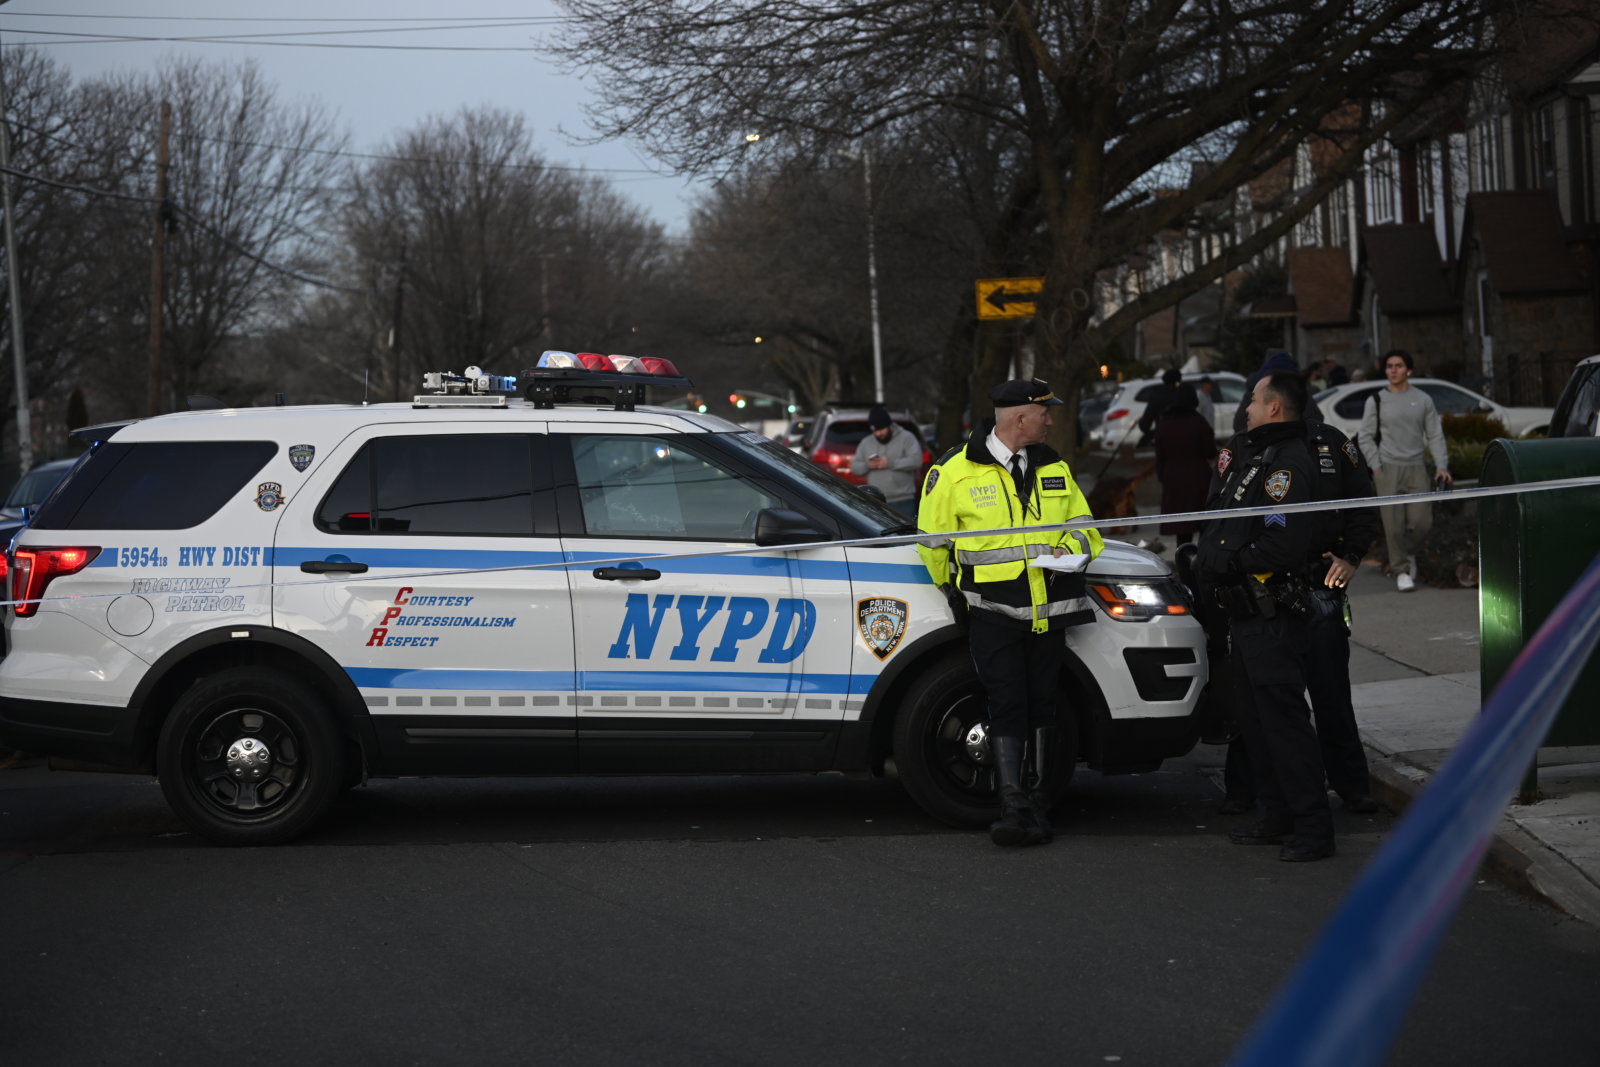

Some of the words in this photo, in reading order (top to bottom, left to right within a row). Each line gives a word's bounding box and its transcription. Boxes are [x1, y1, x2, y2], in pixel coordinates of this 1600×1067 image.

[260, 482, 280, 493] NYPD
[969, 484, 996, 497] NYPD
[973, 495, 997, 503] HIGHWAY
[976, 501, 998, 509] PATROL
[121, 547, 159, 567] 5954
[179, 547, 216, 566] HWY
[222, 547, 260, 566] DIST
[131, 578, 230, 594] HIGHWAY
[165, 595, 245, 612] PATROL
[870, 600, 896, 608] POLICE
[861, 606, 905, 617] DEPARTMENT
[607, 593, 817, 664] NYPD
[861, 624, 870, 639] CITY
[869, 641, 878, 649] OF
[886, 639, 897, 652] NEW
[896, 621, 905, 637] YORK
